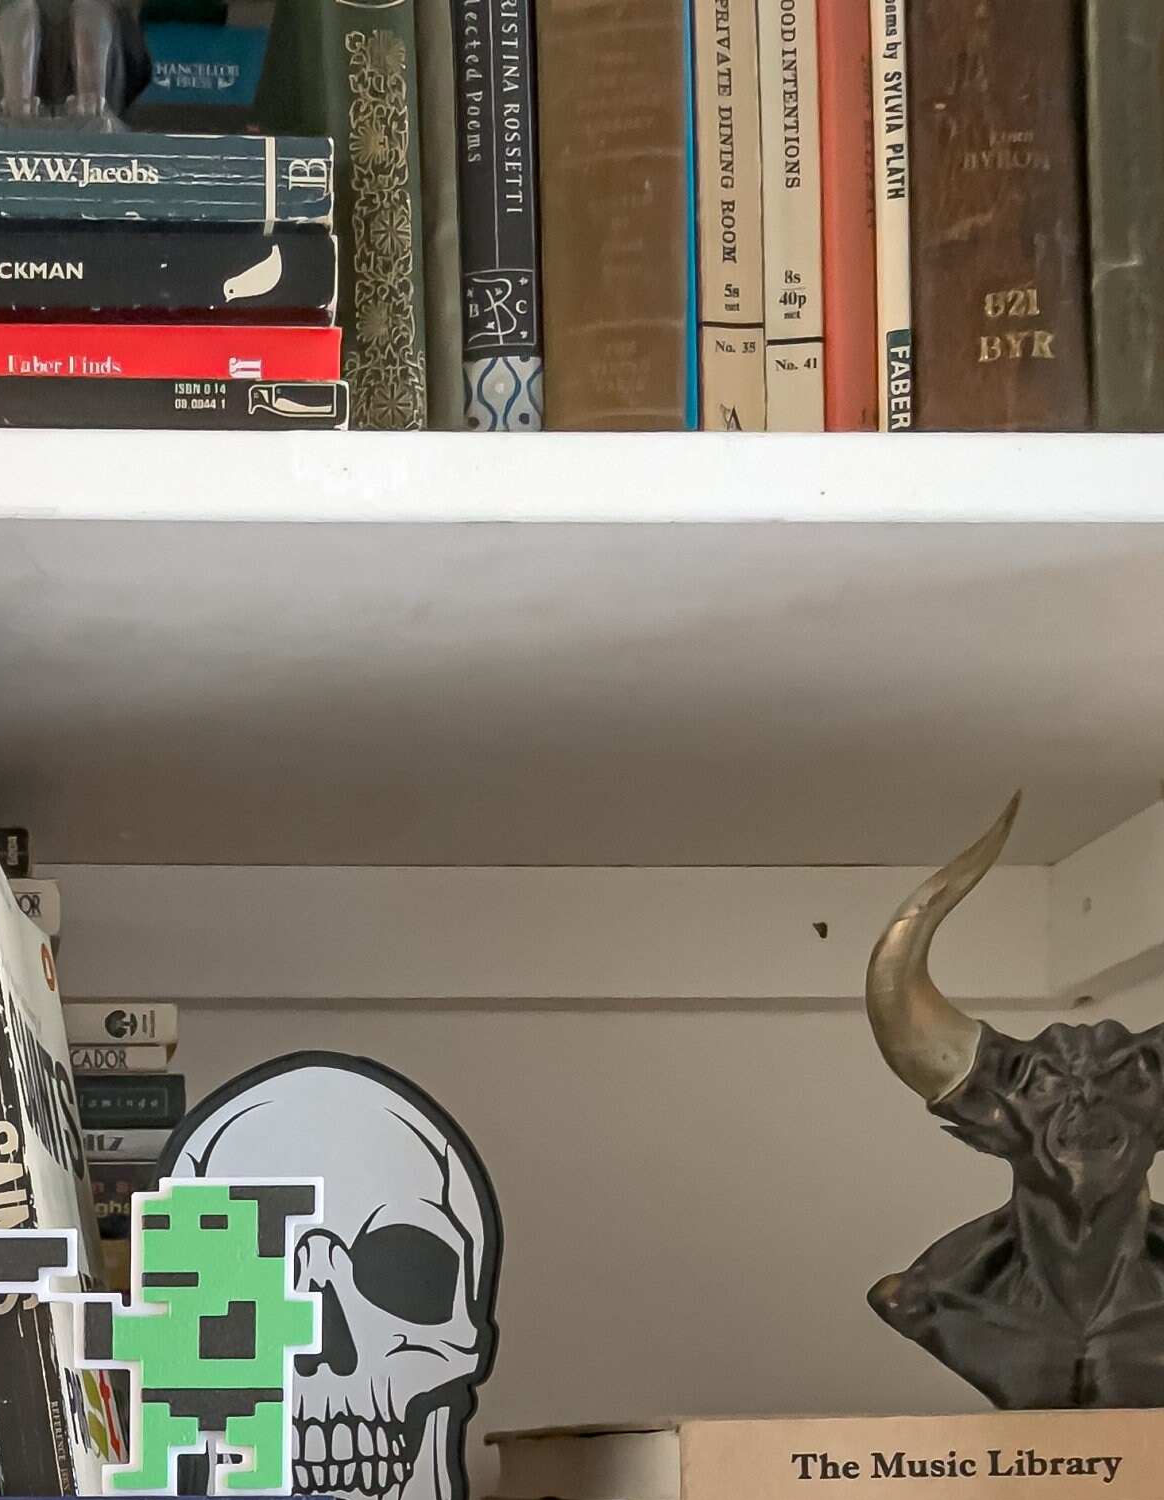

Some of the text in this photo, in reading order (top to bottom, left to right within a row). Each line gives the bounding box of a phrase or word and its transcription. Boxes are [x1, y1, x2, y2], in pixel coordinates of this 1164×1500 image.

[465, 90, 485, 165] Poems
[714, 0, 737, 264] PRIVATE DINING ROOM
[781, 47, 800, 190] INTENTIONS
[883, 41, 905, 200] by SYLVIA PLATH
[504, 102, 524, 215] ROSSETTI
[723, 282, 740, 298] 5s
[784, 270, 802, 285] 8s
[778, 291, 807, 310] 40p
[714, 339, 756, 354] No. 35
[977, 331, 1055, 363] BYR
[775, 357, 818, 371] No. 41
[890, 345, 911, 431] FABER
[791, 1450, 1122, 1483] The Music Library
